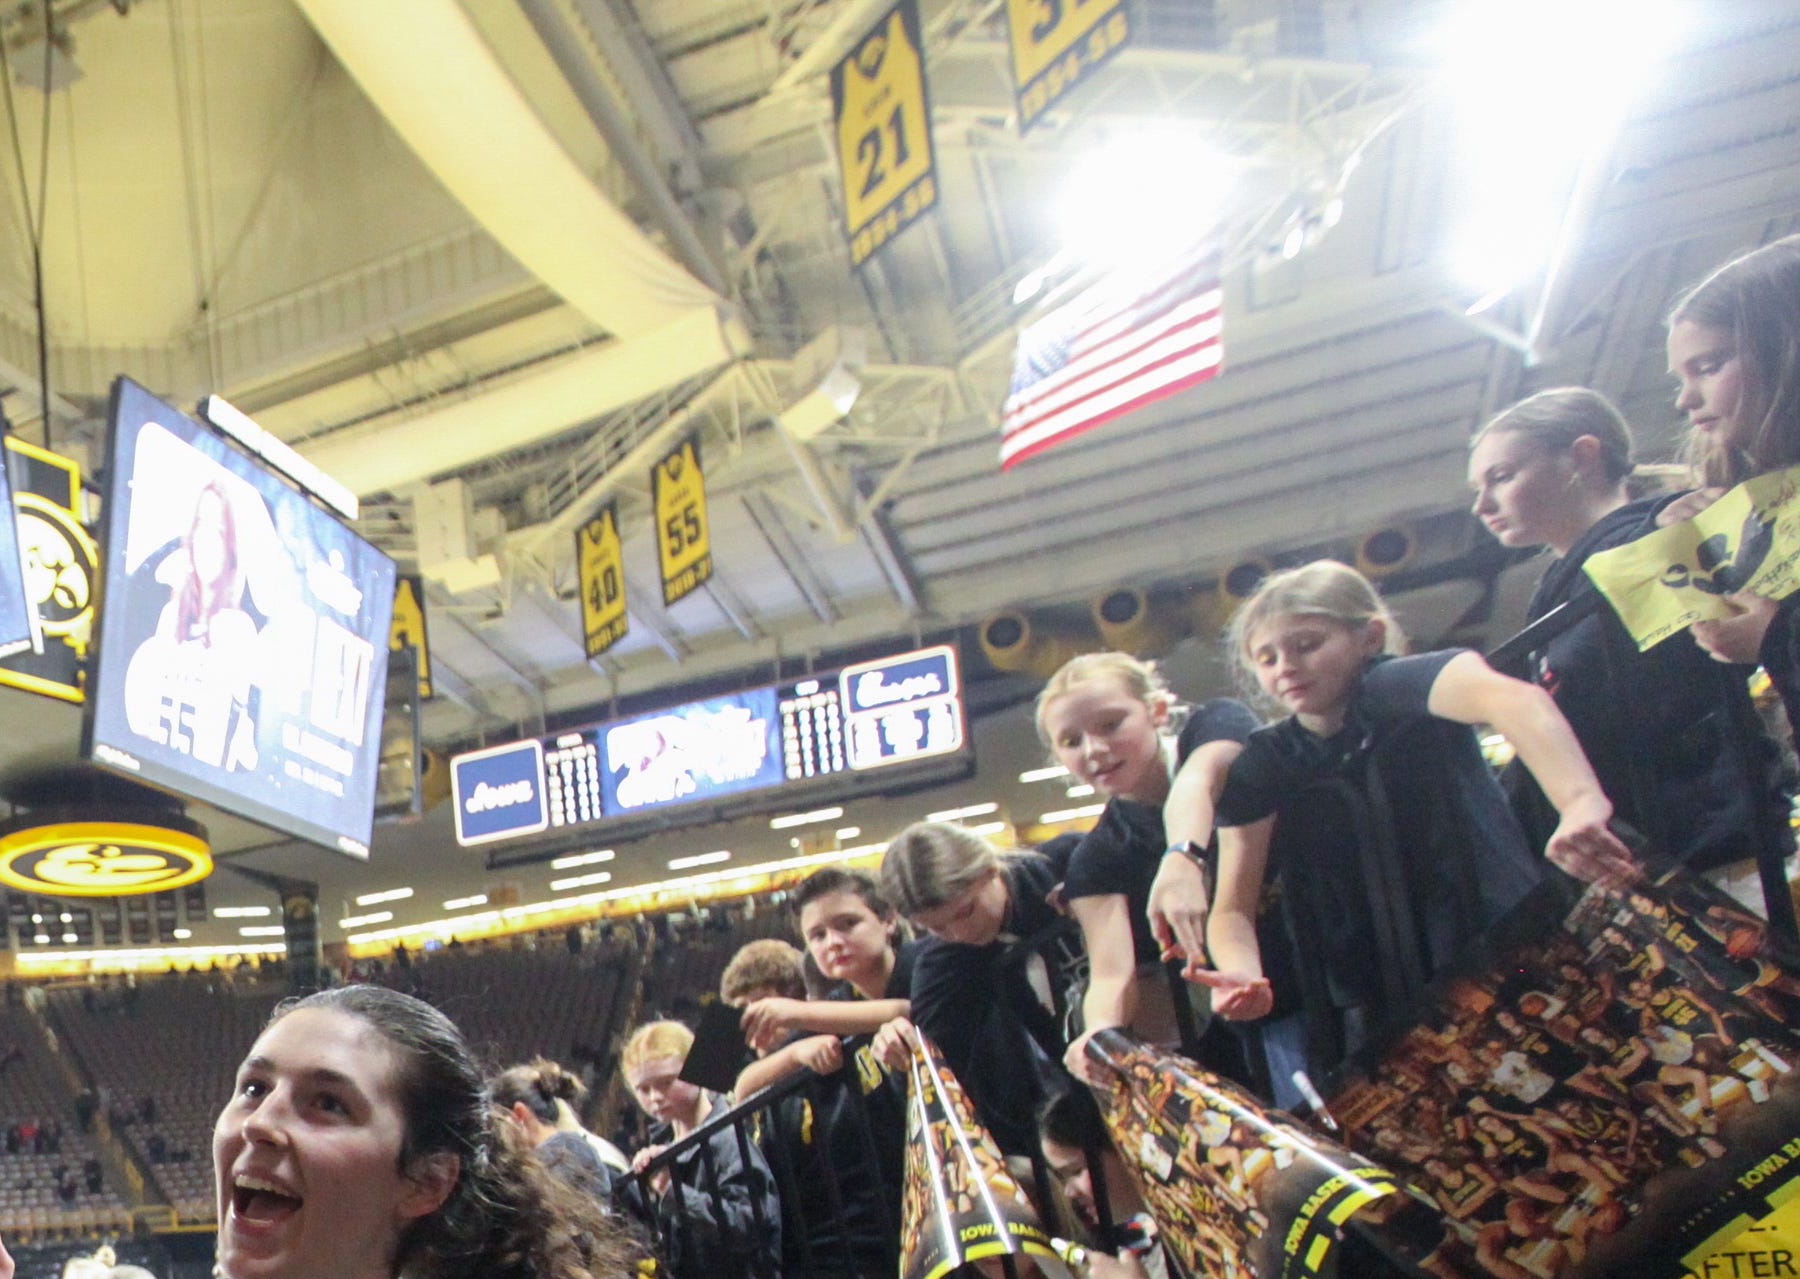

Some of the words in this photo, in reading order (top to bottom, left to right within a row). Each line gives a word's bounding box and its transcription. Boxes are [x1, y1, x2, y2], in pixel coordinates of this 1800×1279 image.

[856, 103, 911, 199] 21
[665, 502, 701, 557] 55
[590, 565, 618, 612] 40
[1737, 1153, 1790, 1190] IOWA
